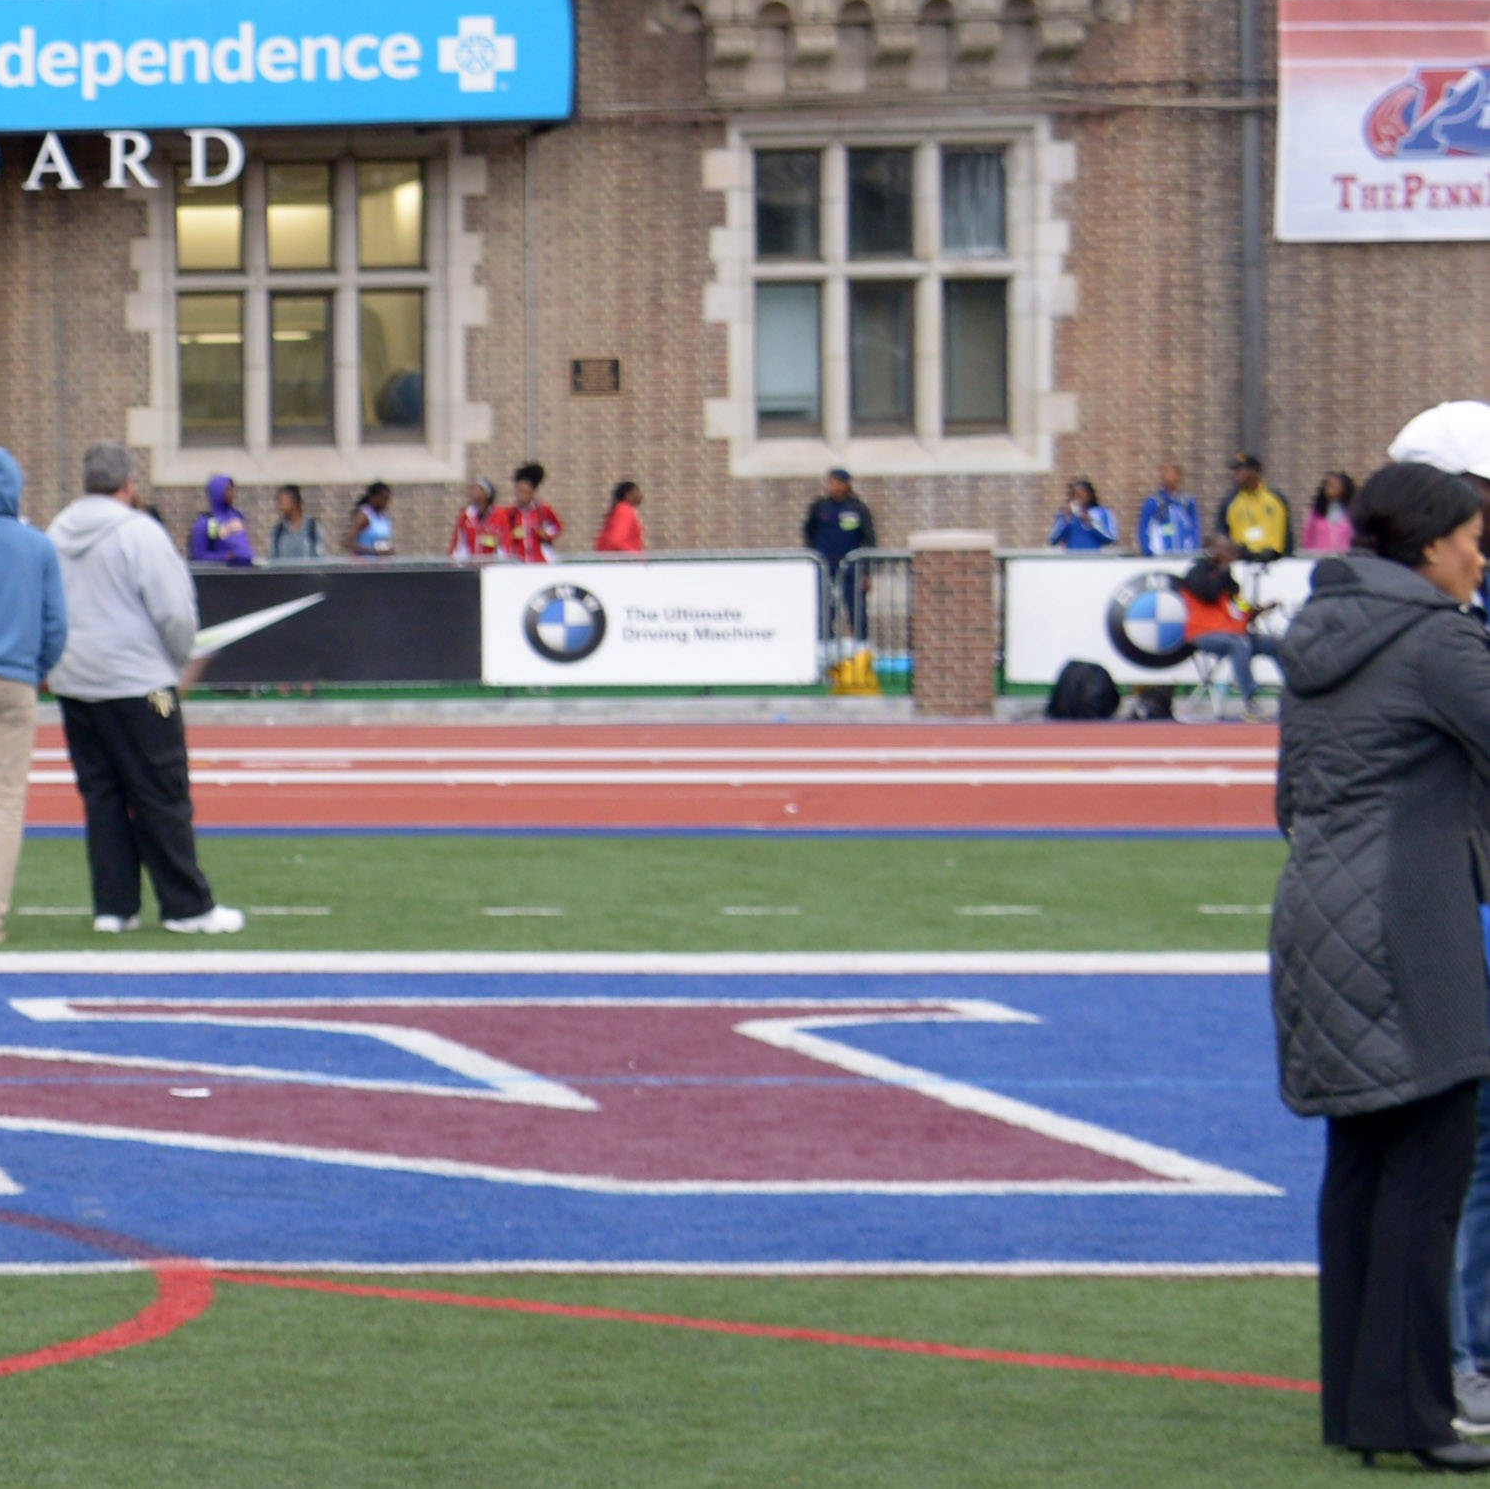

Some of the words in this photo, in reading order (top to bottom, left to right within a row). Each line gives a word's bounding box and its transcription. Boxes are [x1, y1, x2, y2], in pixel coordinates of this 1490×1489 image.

[626, 607, 658, 620] The
[663, 606, 742, 620] Ultimate
[622, 627, 687, 643] Driving
[693, 626, 773, 641] Machine
